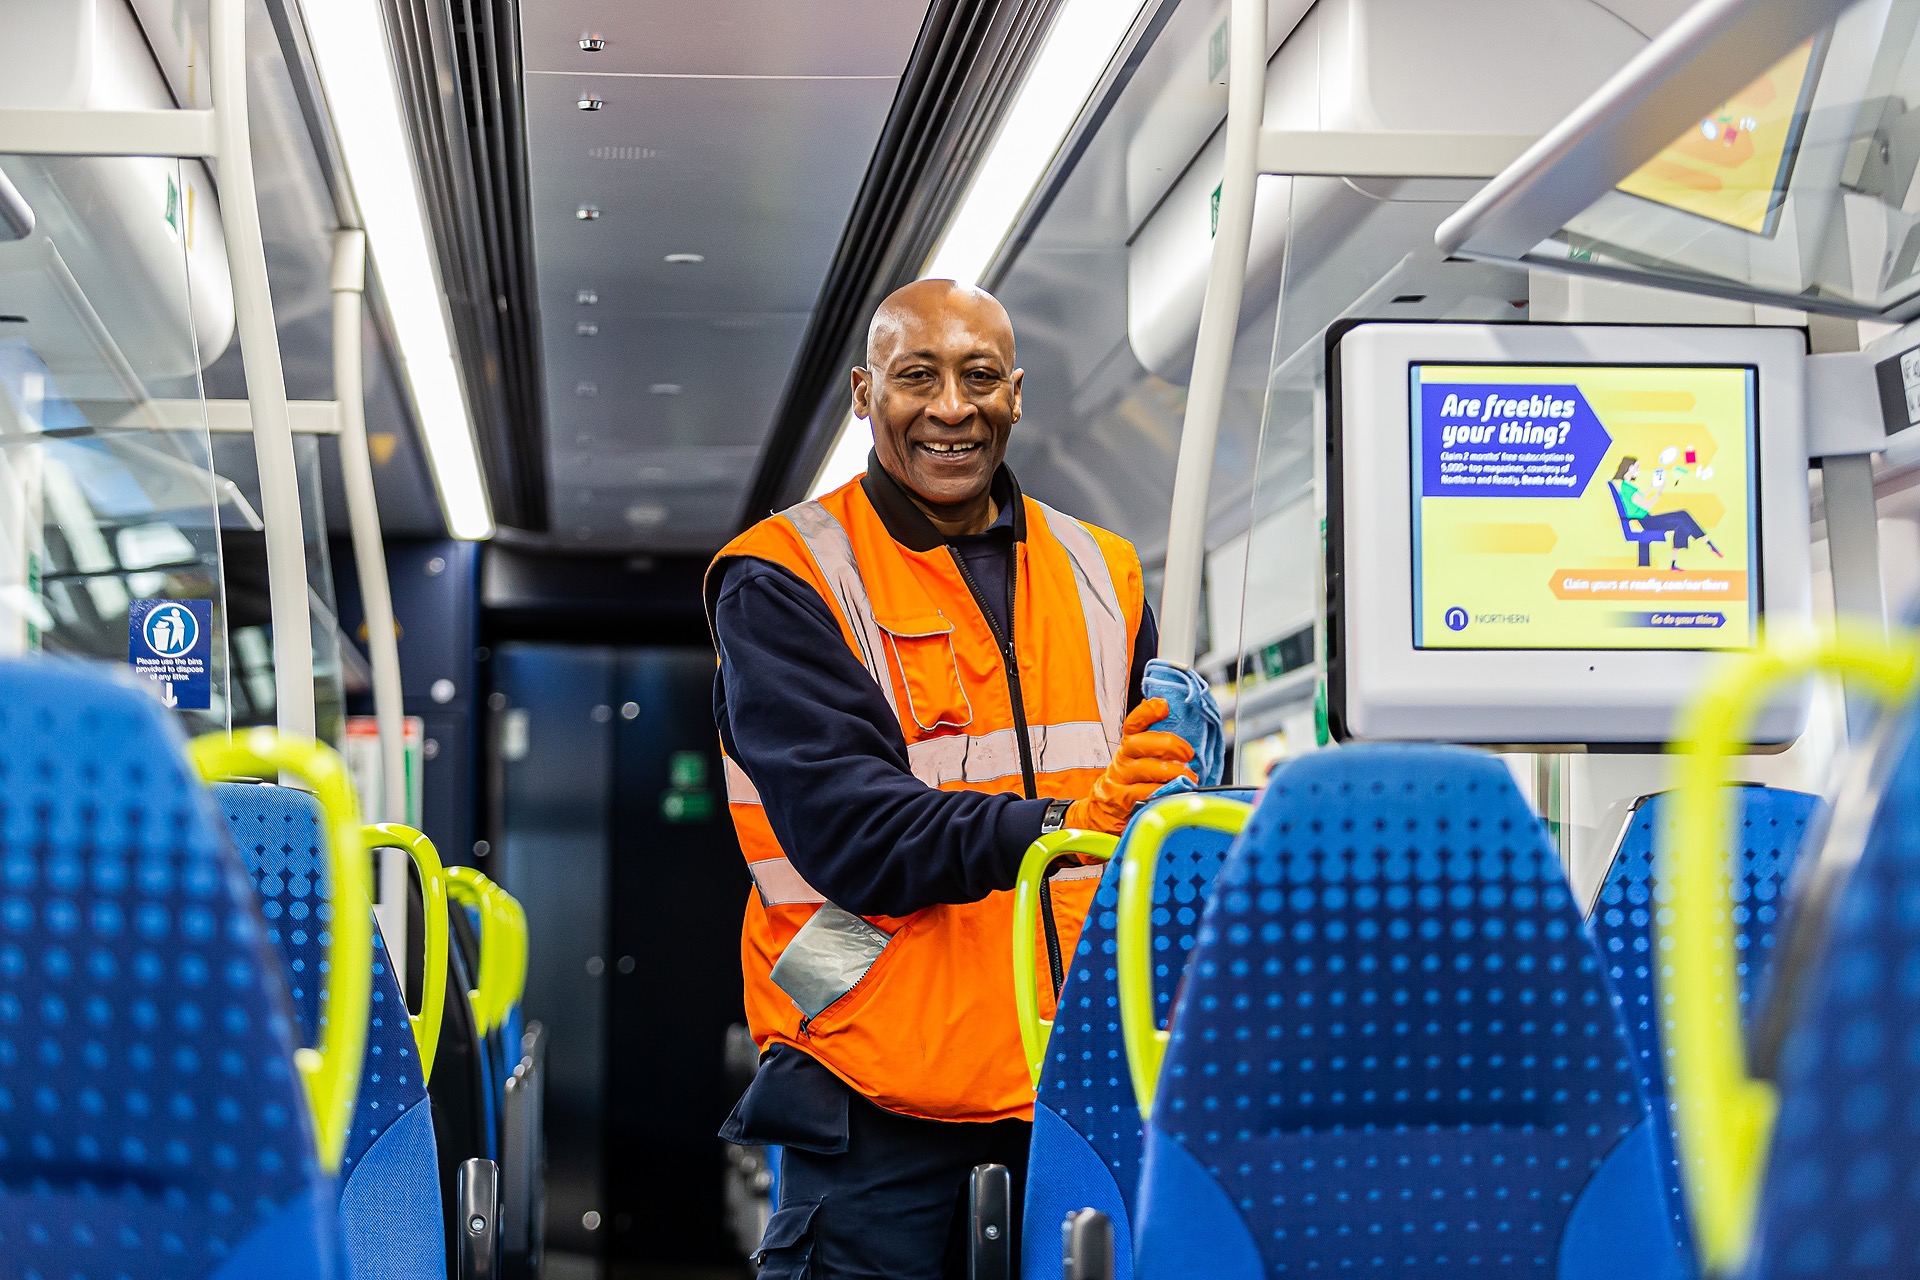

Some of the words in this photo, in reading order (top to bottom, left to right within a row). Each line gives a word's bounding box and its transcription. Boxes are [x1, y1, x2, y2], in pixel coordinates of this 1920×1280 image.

[1440, 393, 1481, 418] Are
[1480, 393, 1576, 422] freebies
[1442, 425, 1496, 449] your
[1498, 421, 1571, 449] thing?
[1440, 451, 1463, 462] Claim
[1463, 451, 1470, 461] 2
[1501, 451, 1518, 462] free
[1517, 452, 1565, 463] subscription
[1565, 452, 1575, 462] to
[1468, 463, 1483, 474] top
[1526, 464, 1561, 475] courtesy
[1560, 463, 1571, 473] of
[1440, 474, 1477, 485] Northern
[1476, 474, 1492, 485] and
[1521, 474, 1545, 486] Beats
[1544, 474, 1577, 488] driving!
[1563, 578, 1590, 591] Claim
[1591, 579, 1618, 592] yours
[1618, 579, 1630, 591] at
[1474, 613, 1531, 624] NORTHERN
[1651, 614, 1664, 625] Go
[1663, 614, 1675, 625] do
[1675, 615, 1696, 627] your
[1695, 614, 1719, 627] thing
[136, 657, 160, 665] Please
[174, 657, 187, 665] the
[187, 657, 203, 665] bins
[135, 665, 167, 674] provided
[176, 665, 205, 674] dispose
[150, 672, 158, 680] of
[158, 673, 171, 681] any
